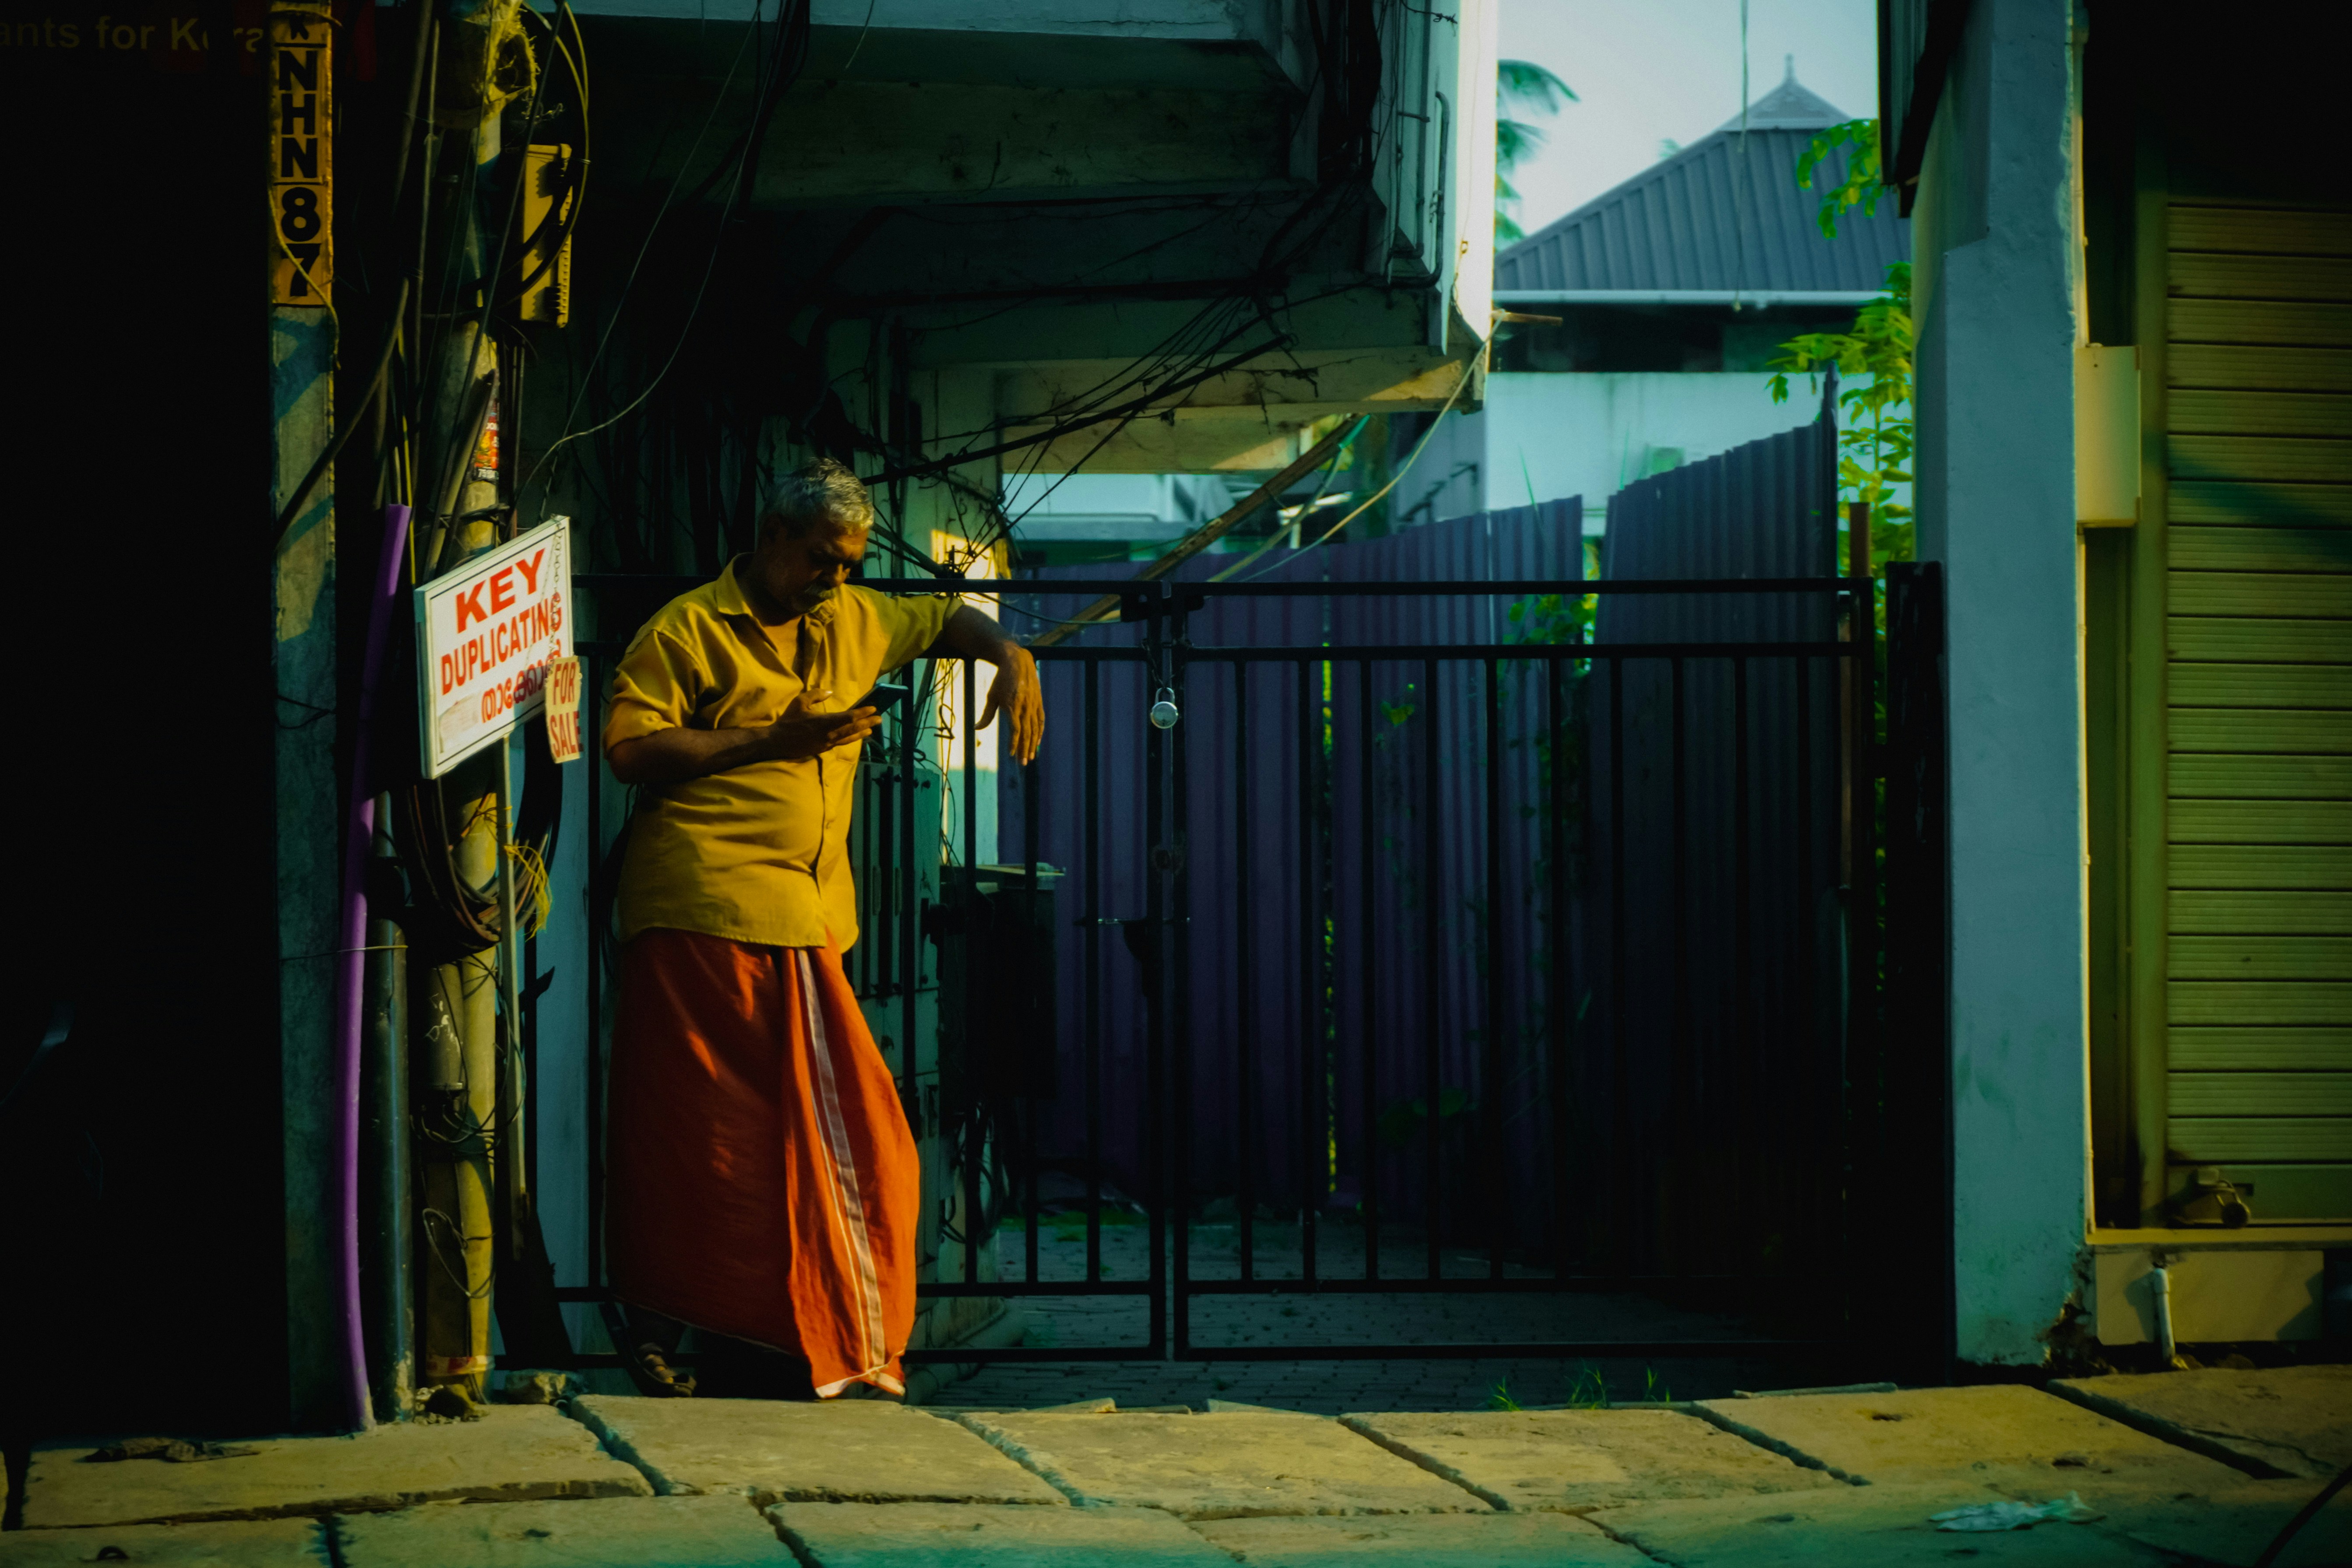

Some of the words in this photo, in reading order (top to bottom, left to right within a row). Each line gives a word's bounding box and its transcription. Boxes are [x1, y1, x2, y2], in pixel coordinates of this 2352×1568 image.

[95, 15, 156, 50] for
[279, 50, 317, 178] NHN
[280, 187, 321, 297] 87
[456, 548, 545, 634] KEY
[441, 592, 561, 696] DUPLICATING
[553, 661, 576, 705] FOR
[550, 710, 584, 758] SALE
